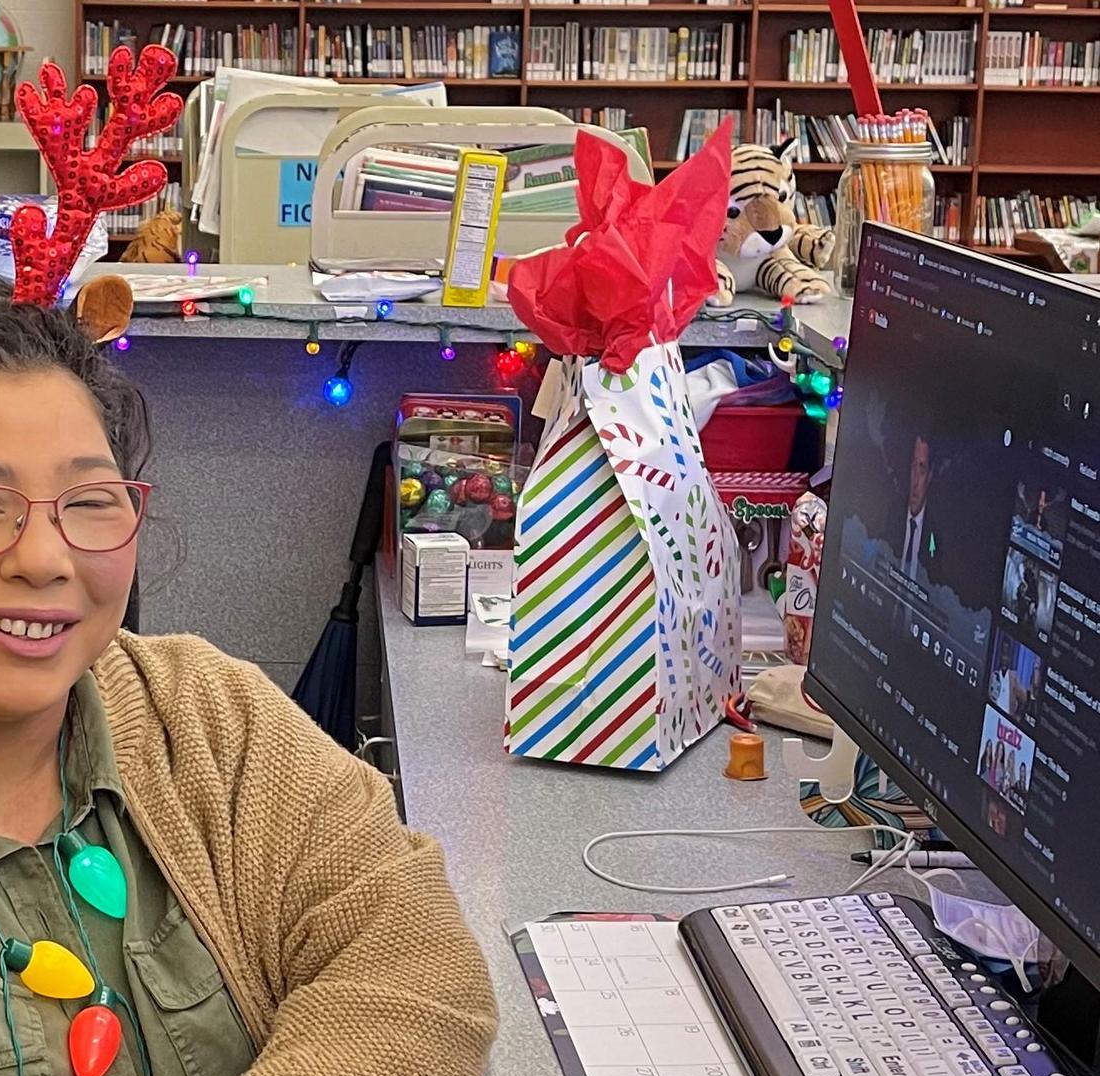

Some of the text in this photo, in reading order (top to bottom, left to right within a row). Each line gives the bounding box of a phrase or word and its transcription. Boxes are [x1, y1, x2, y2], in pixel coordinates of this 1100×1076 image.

[524, 171, 561, 188] Aaron
[820, 964, 842, 972] G
[827, 976, 850, 984] H
[798, 984, 821, 992] N
[806, 996, 830, 1005] M
[843, 1000, 867, 1008] K
[884, 1008, 906, 1016] O
[852, 1013, 873, 1021] L
[845, 1058, 870, 1074] Shift
[882, 1055, 907, 1076] Enter
